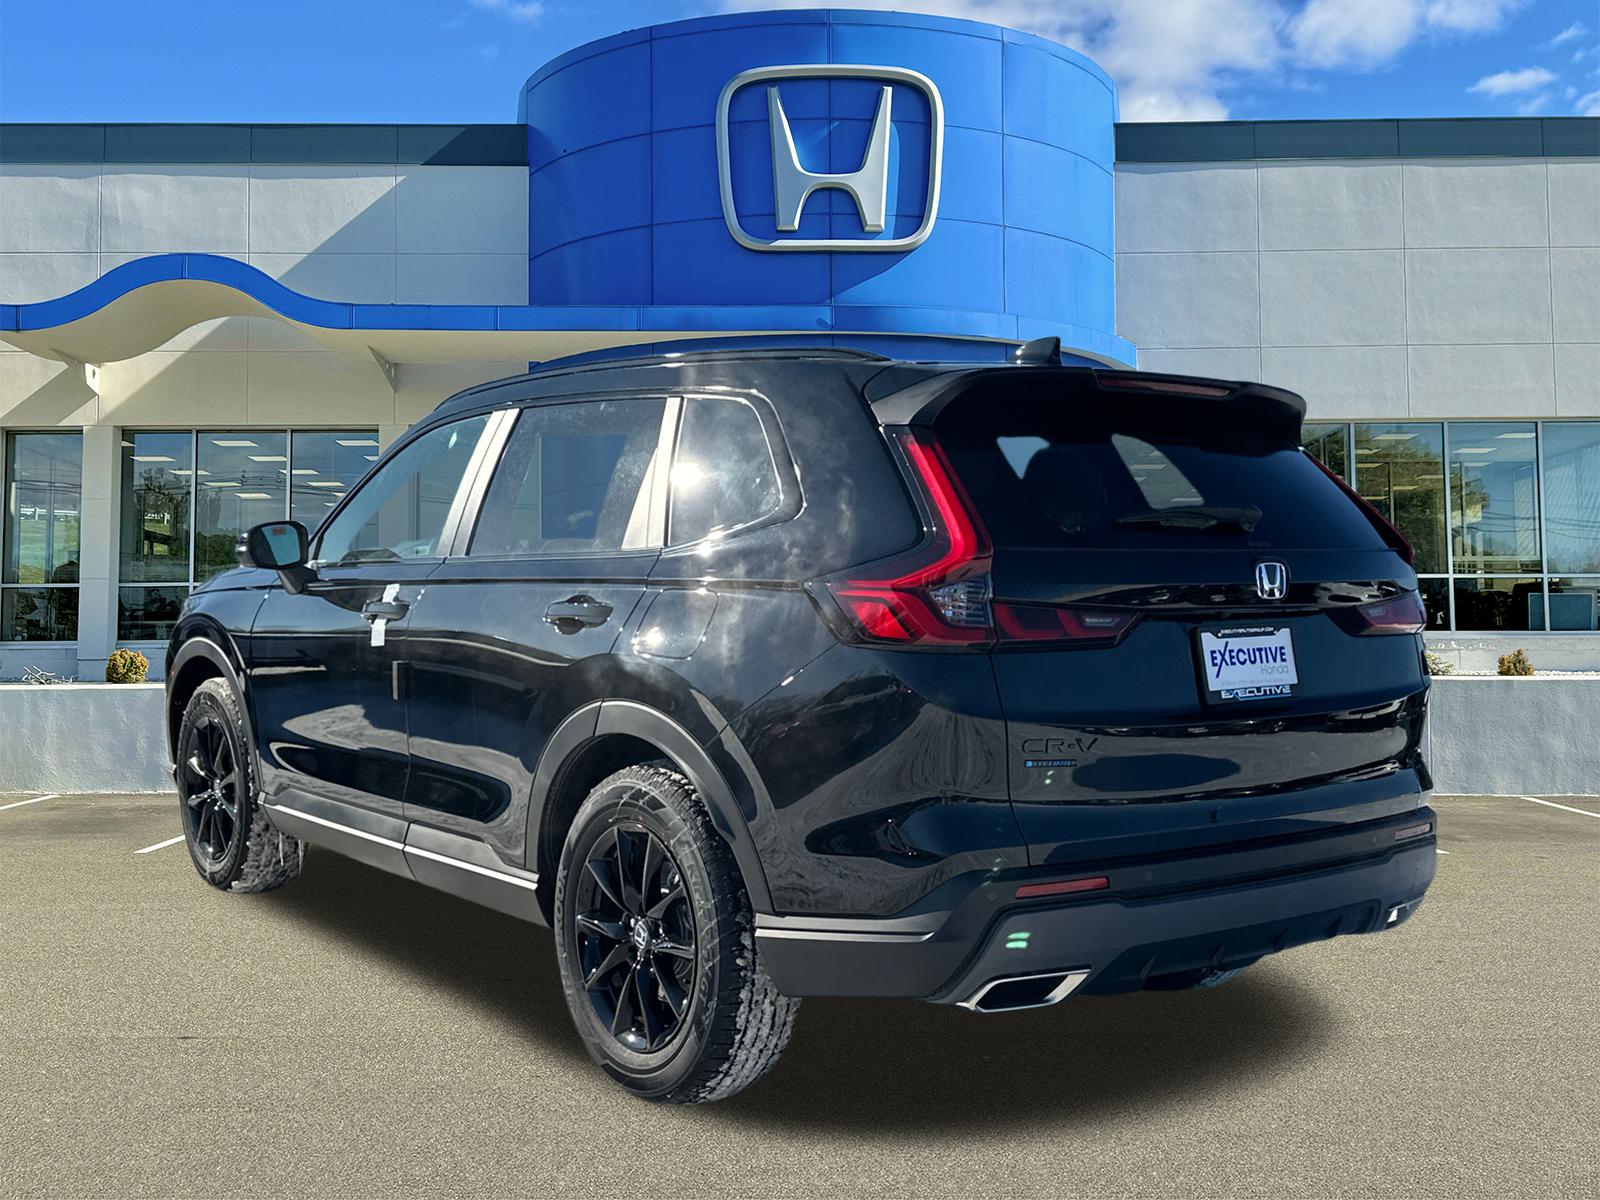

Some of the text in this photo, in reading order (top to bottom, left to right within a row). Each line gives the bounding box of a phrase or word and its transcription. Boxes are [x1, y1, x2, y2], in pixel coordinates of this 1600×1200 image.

[1210, 641, 1287, 678] EXECUTIVE
[1221, 685, 1291, 699] EXECUTIVE
[1022, 738, 1098, 754] CR-V
